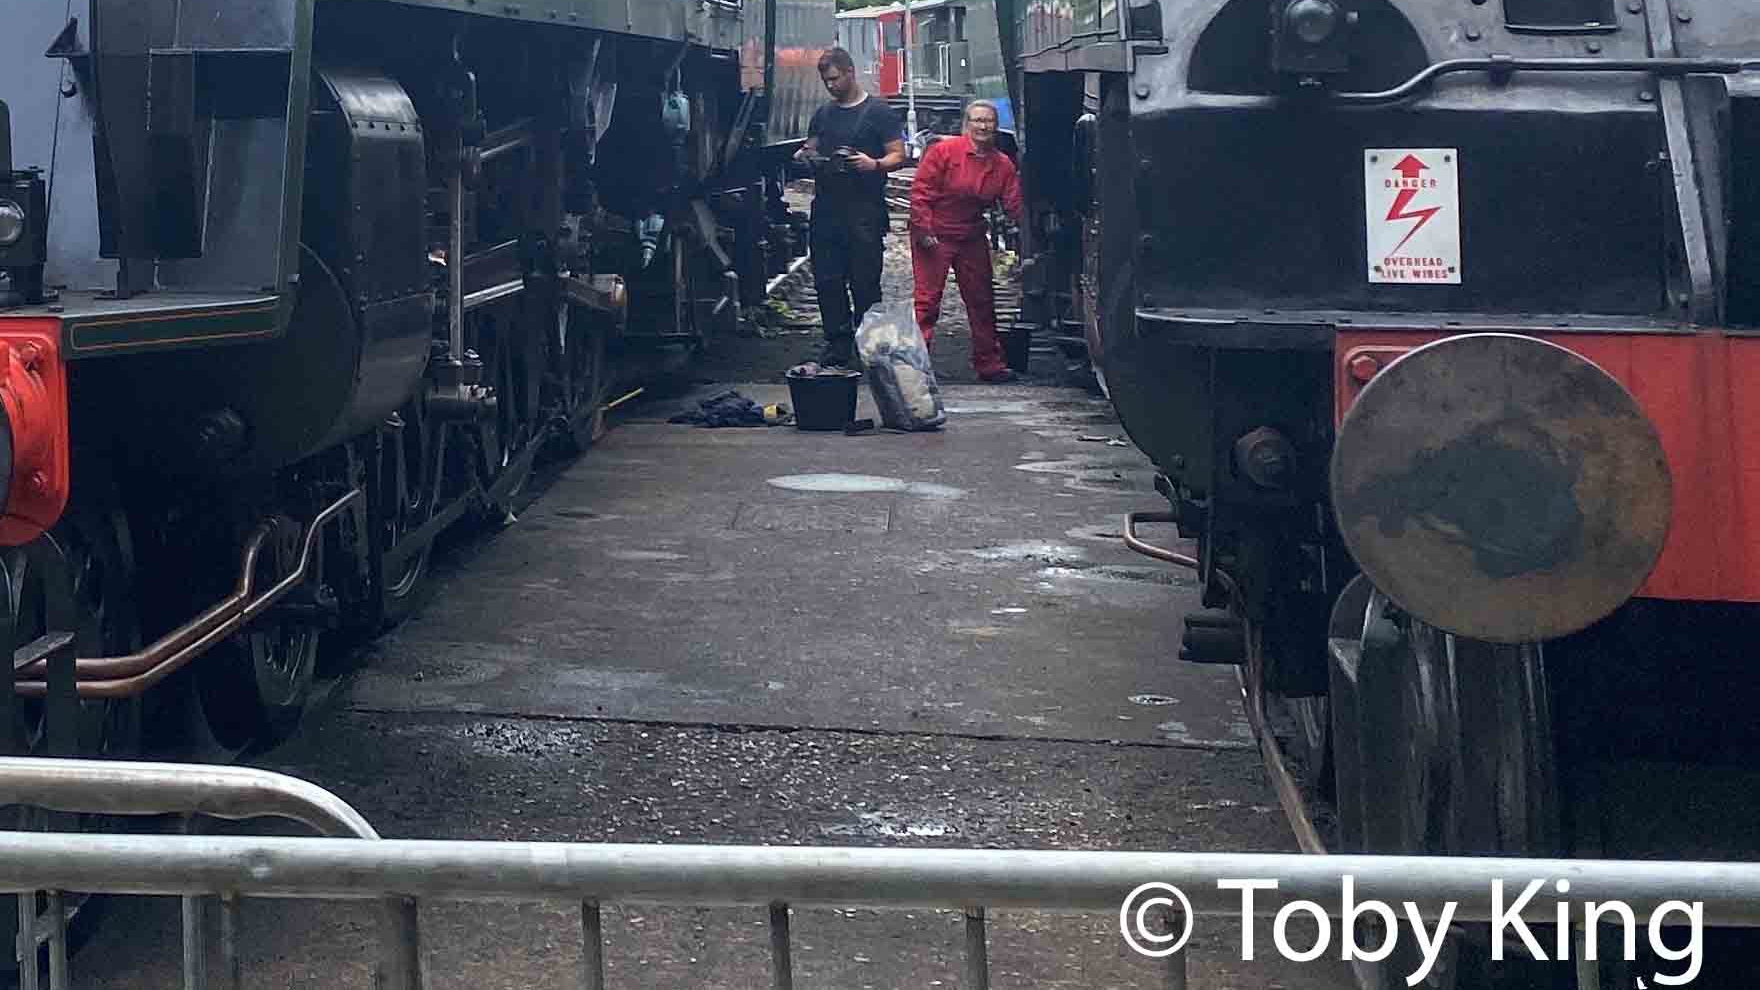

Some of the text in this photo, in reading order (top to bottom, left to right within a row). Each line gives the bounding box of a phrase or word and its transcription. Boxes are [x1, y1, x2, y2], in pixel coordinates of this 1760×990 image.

[1384, 178, 1438, 188] DANGER
[1383, 257, 1444, 267] OVERHEAD
[1380, 269, 1407, 279] LIVE
